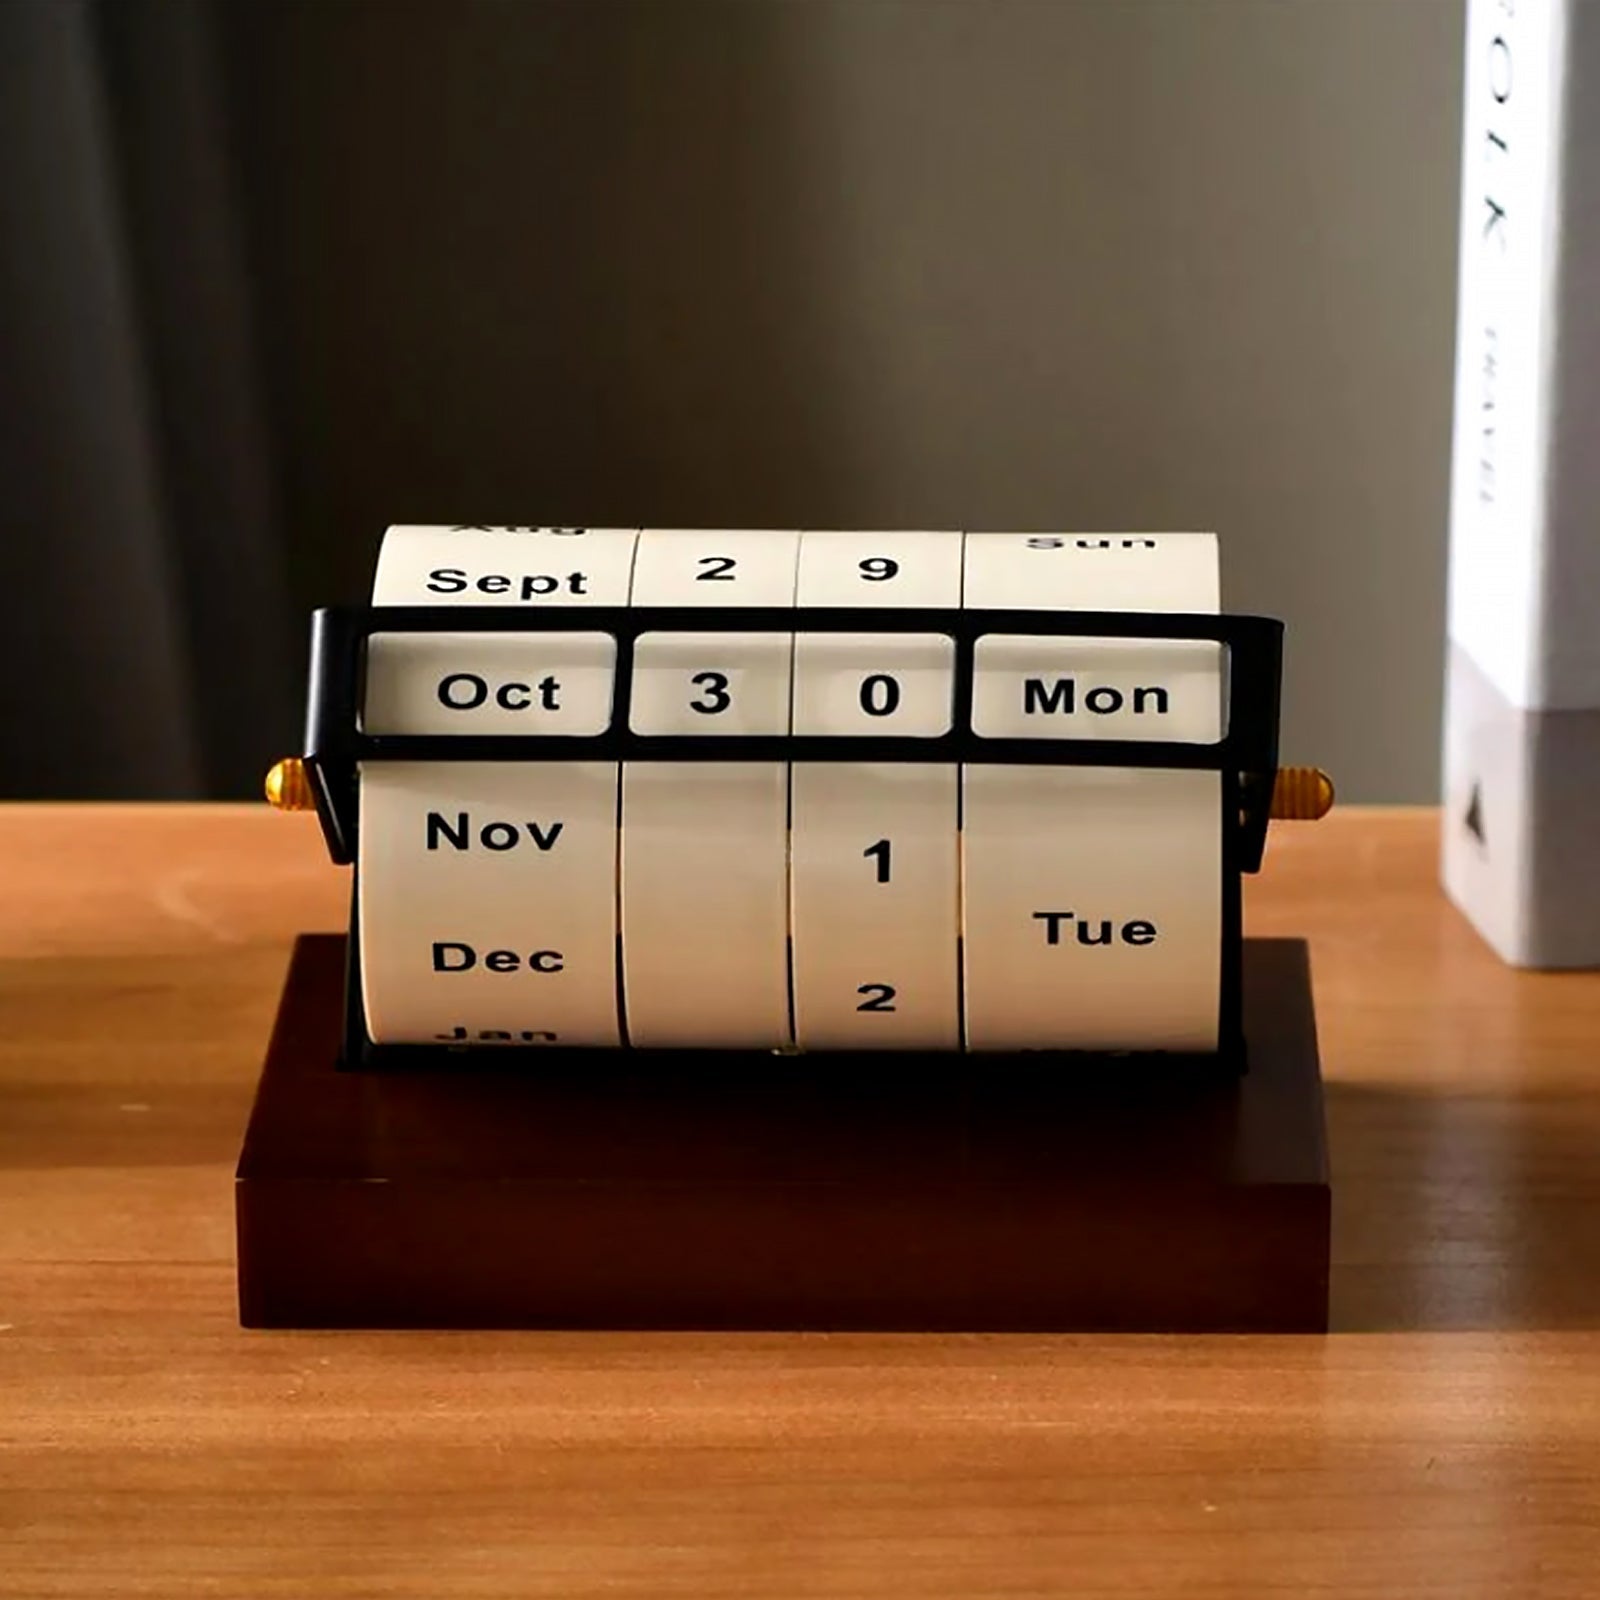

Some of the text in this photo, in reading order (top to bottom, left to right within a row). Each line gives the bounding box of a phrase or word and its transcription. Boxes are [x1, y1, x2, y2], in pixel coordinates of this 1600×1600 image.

[1026, 537, 1157, 550] Sun
[426, 557, 900, 601] Sept 2 9
[437, 672, 1169, 718] Oct 3 0 Mon
[427, 812, 565, 851] Nov
[863, 838, 892, 884] 1
[1032, 912, 1158, 946] Tue
[432, 942, 565, 973] Dec
[856, 983, 897, 1012] 2
[434, 1026, 558, 1042] Jan
